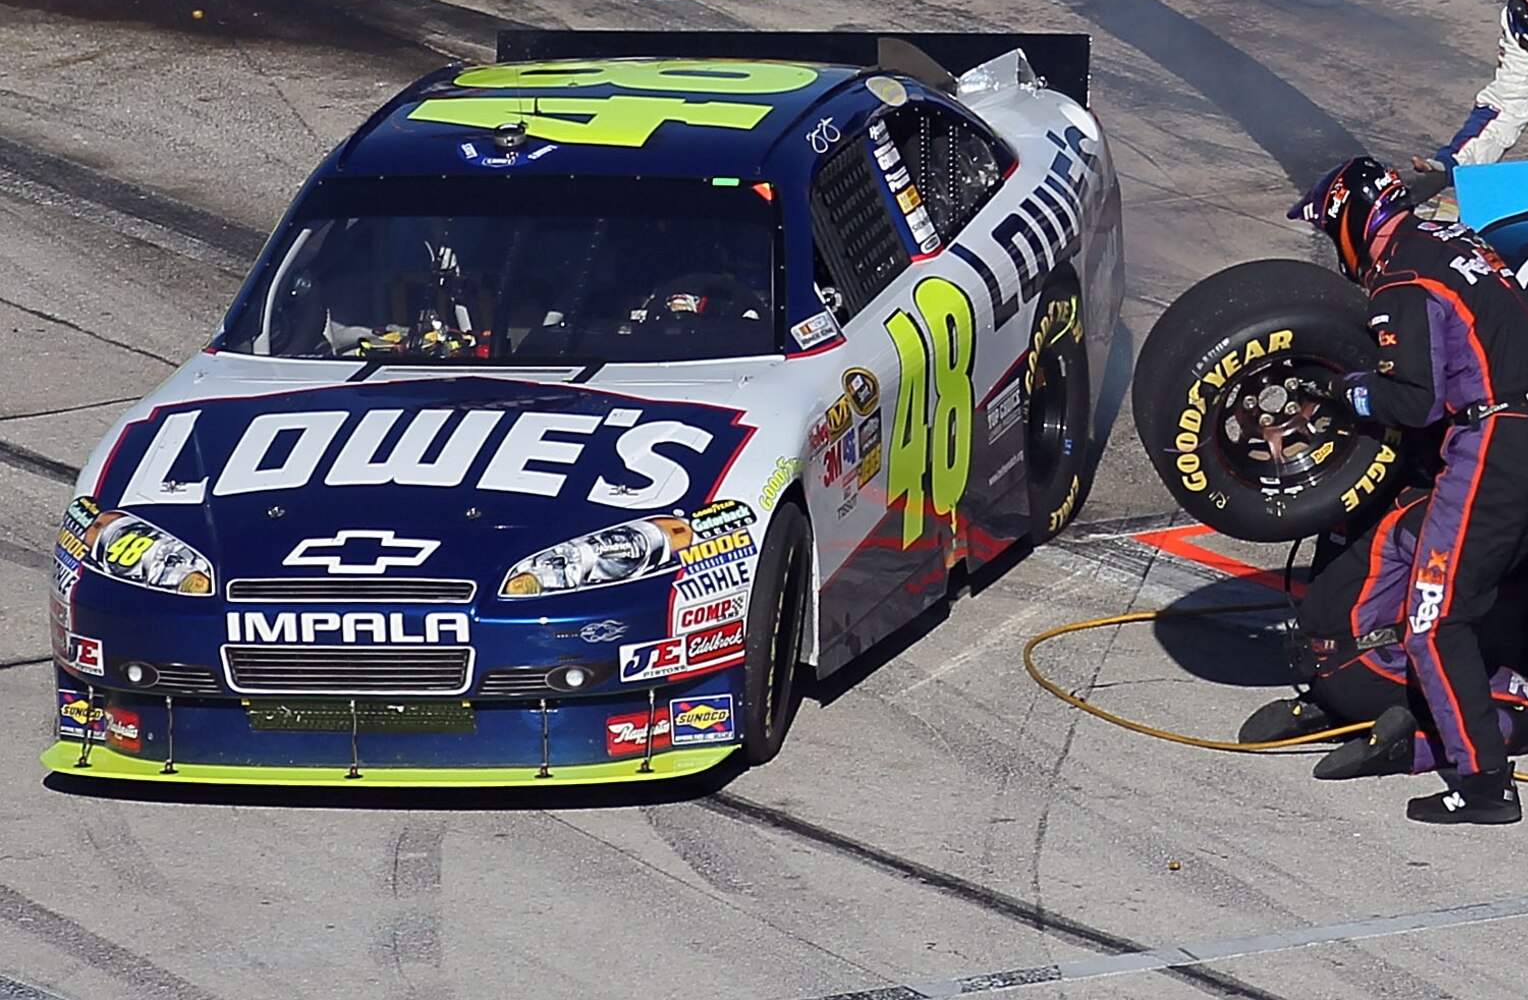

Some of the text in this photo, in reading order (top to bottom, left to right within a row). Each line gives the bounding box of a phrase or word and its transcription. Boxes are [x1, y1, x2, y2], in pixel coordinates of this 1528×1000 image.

[407, 57, 819, 148] 48
[949, 125, 1097, 332] LOWE'S
[884, 278, 976, 551] 48
[1175, 328, 1295, 494] GOODYEAR
[117, 408, 715, 510] LOWE'S
[1339, 429, 1402, 514] EAGLE
[691, 499, 736, 518] GOODYEAR
[692, 505, 751, 532] Gatorback
[702, 516, 755, 540] BELTS
[106, 532, 154, 567] 48
[679, 529, 752, 565] MOOG
[676, 560, 750, 601] MAHLE
[1409, 550, 1450, 635] FedEx
[226, 611, 471, 643] IMPALA
[680, 599, 733, 629] COMP
[688, 624, 744, 658] Edelbrock
[623, 639, 684, 680] JE
[643, 664, 688, 679] PISTONS
[63, 705, 103, 720] SUNOCO
[677, 709, 728, 724] SUNOCO
